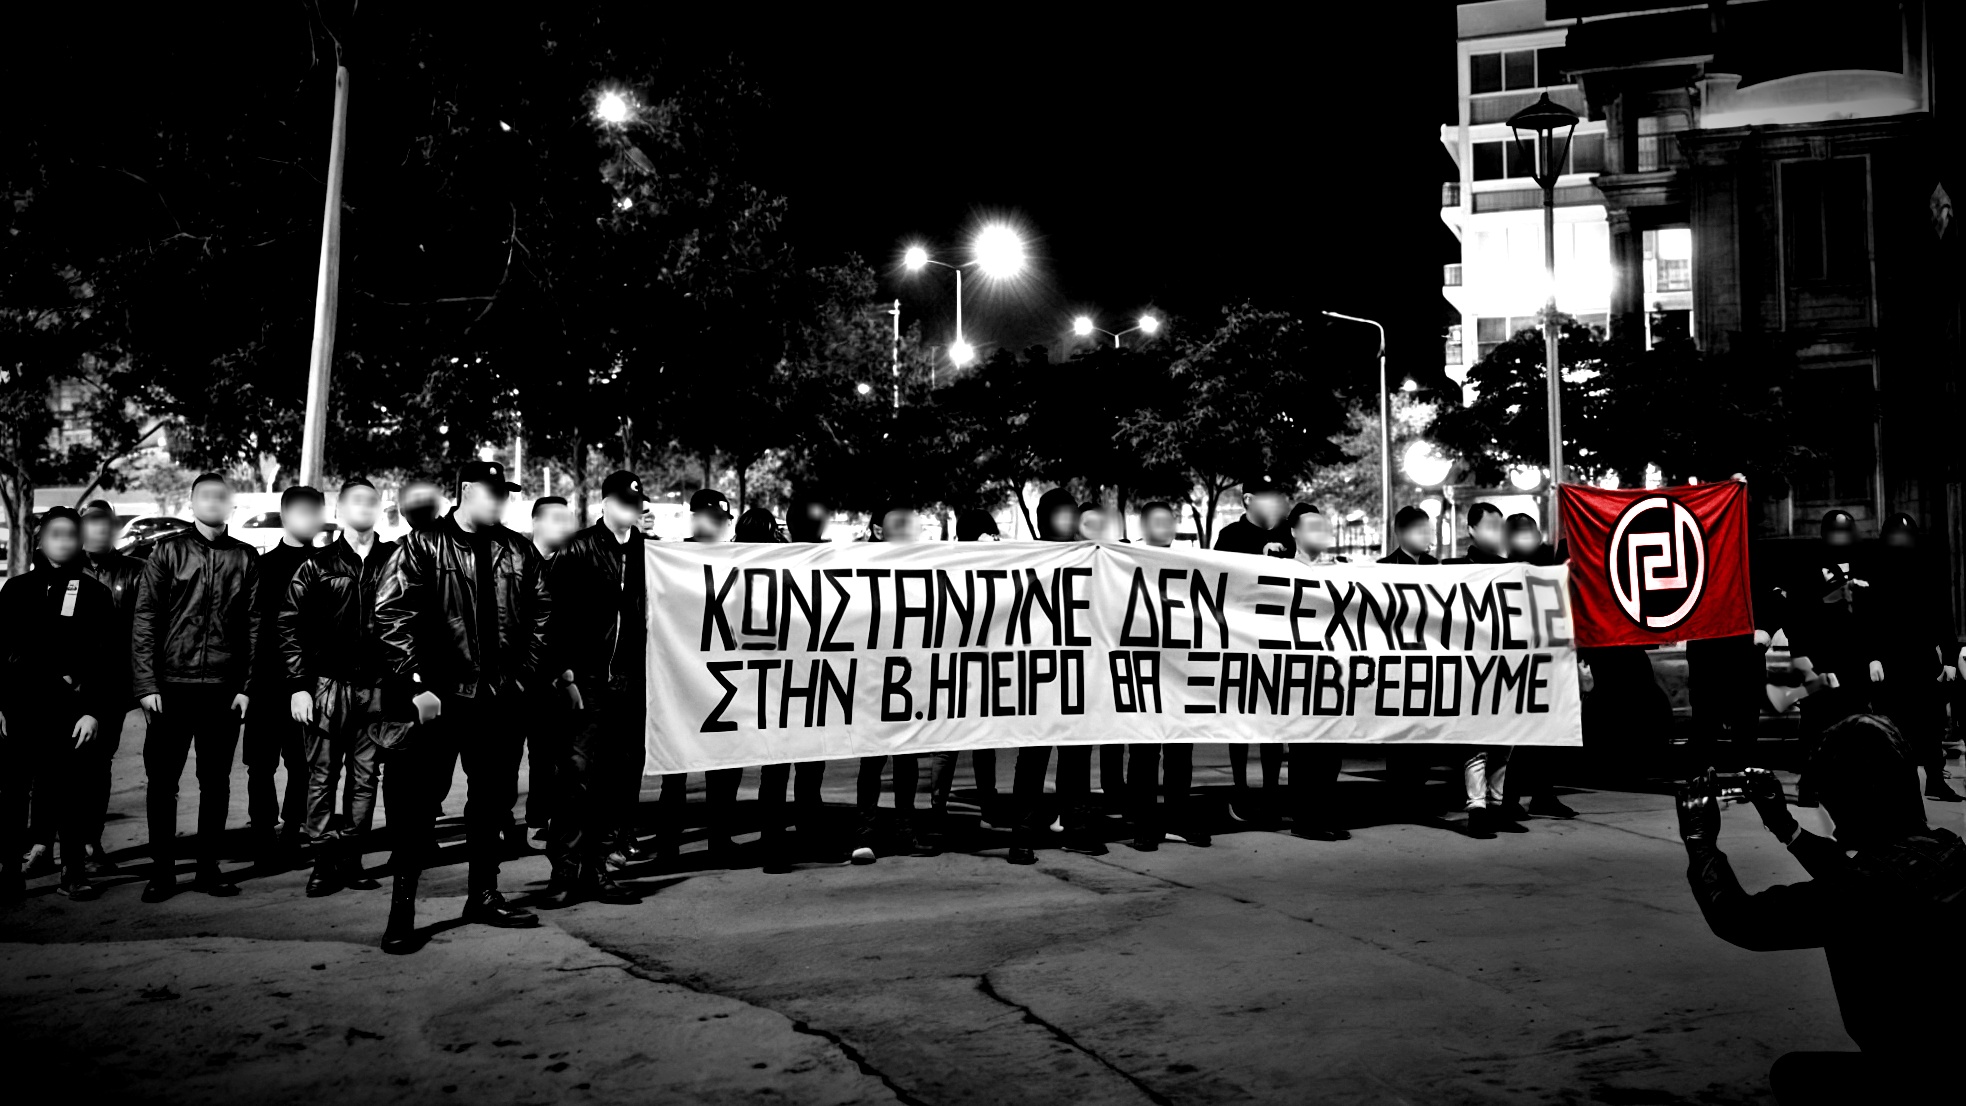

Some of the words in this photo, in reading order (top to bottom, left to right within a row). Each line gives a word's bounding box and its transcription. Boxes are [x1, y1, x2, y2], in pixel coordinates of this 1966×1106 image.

[700, 564, 1093, 652] ΚΩΝΣΤΑΝΤΙΝΕ
[1119, 566, 1229, 650] ΔΕΝ
[1254, 575, 1529, 652] ΞΕΧΝΟΥΜΕ
[699, 657, 858, 733] ΣΤΗΝ
[880, 649, 1085, 722] Β.ΗΠΕΙΡΟ
[1108, 649, 1163, 714] ΘΑ
[1184, 651, 1554, 717] ΞΑΝΑΒΡΕΘΟΥΜΕ
